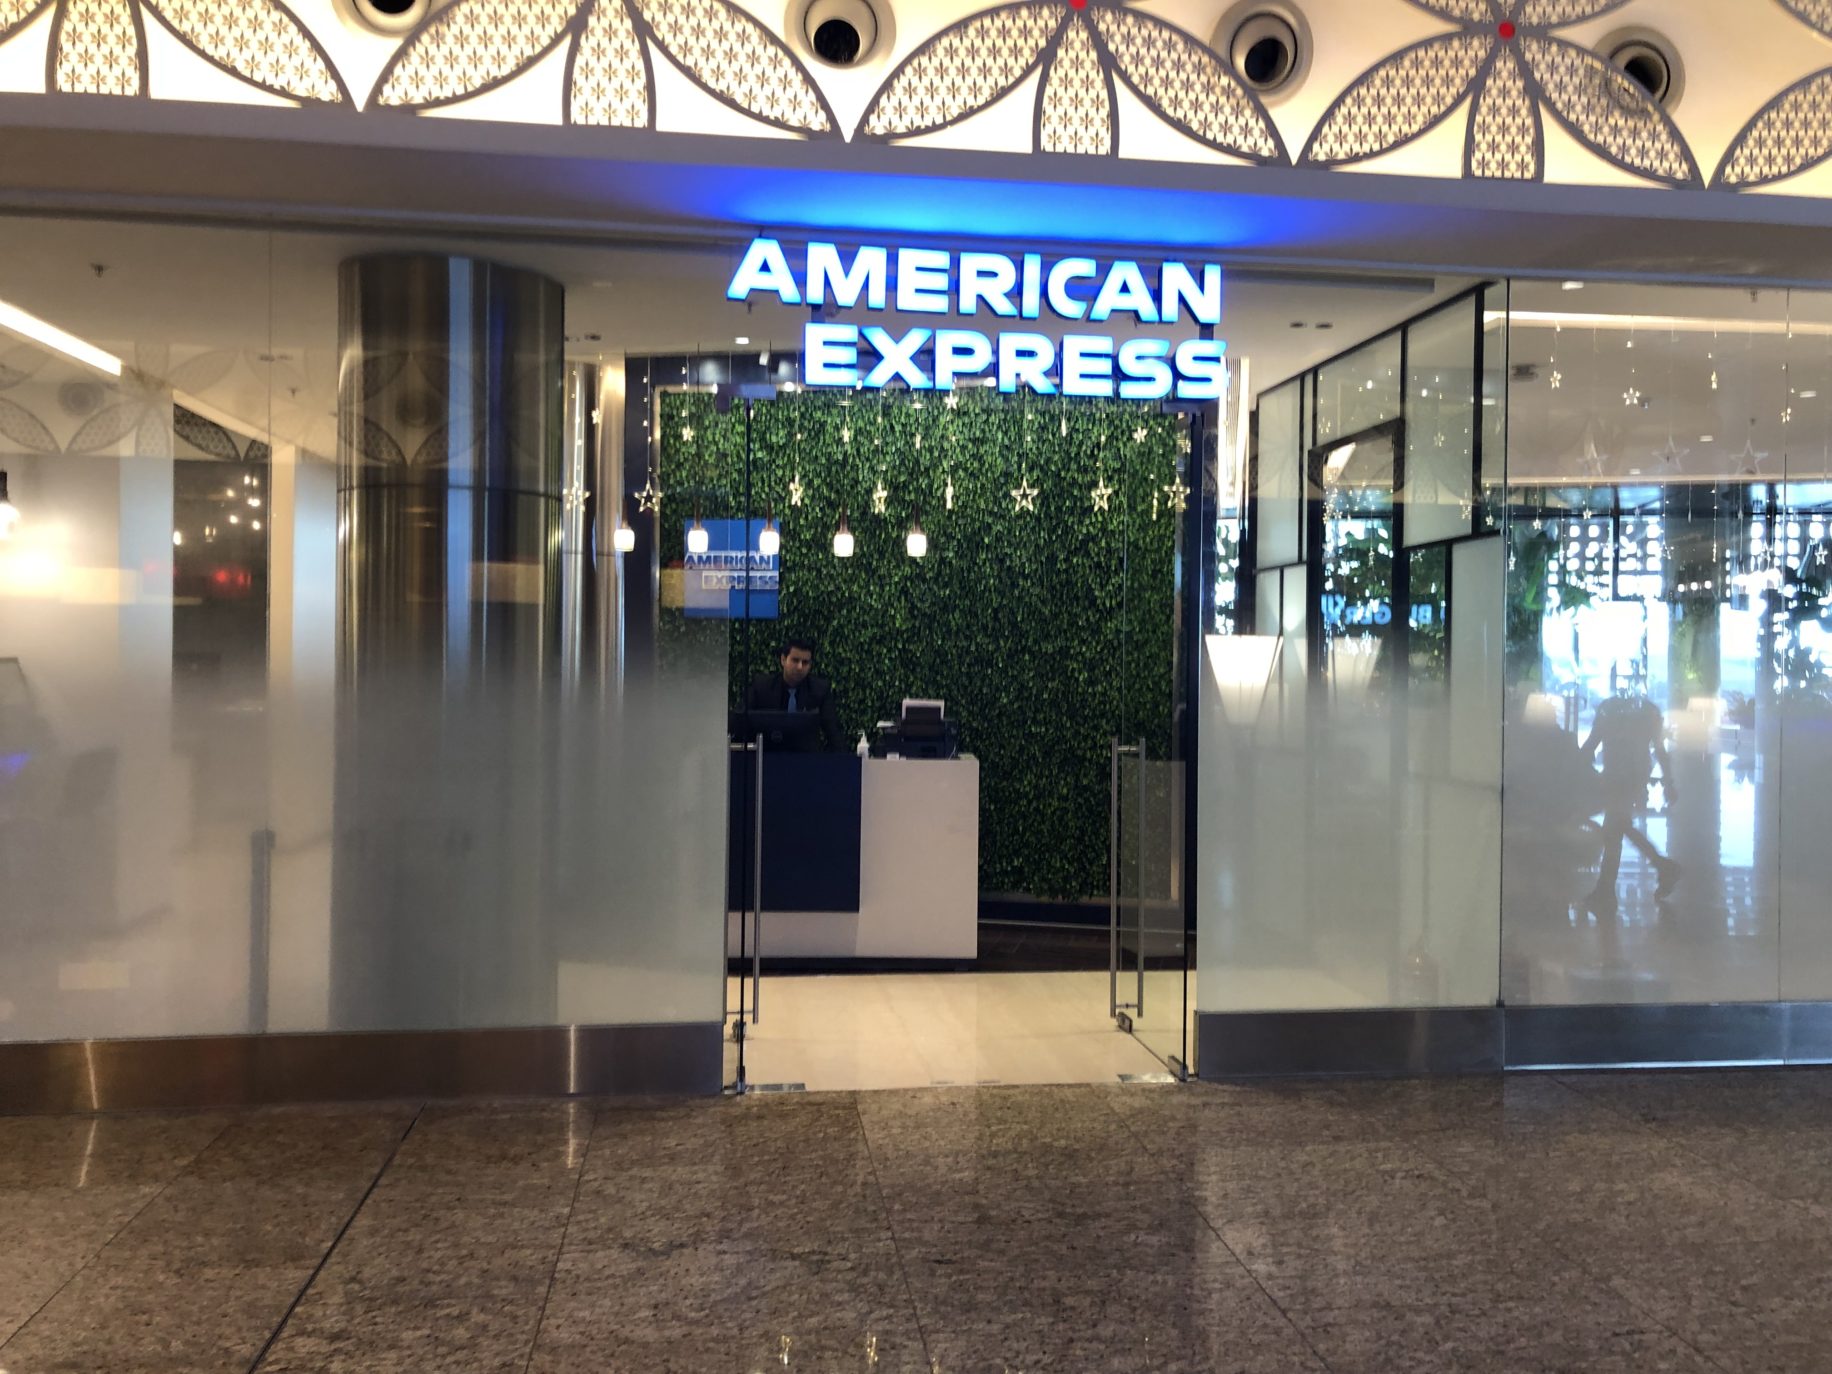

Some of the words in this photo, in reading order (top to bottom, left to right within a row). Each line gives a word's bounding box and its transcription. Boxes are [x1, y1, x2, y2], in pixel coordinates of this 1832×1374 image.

[727, 237, 1222, 324] AMERICAN
[804, 322, 1228, 399] EXPRESS
[684, 551, 773, 570] AMERICAN
[702, 571, 779, 590] EXPRESS
